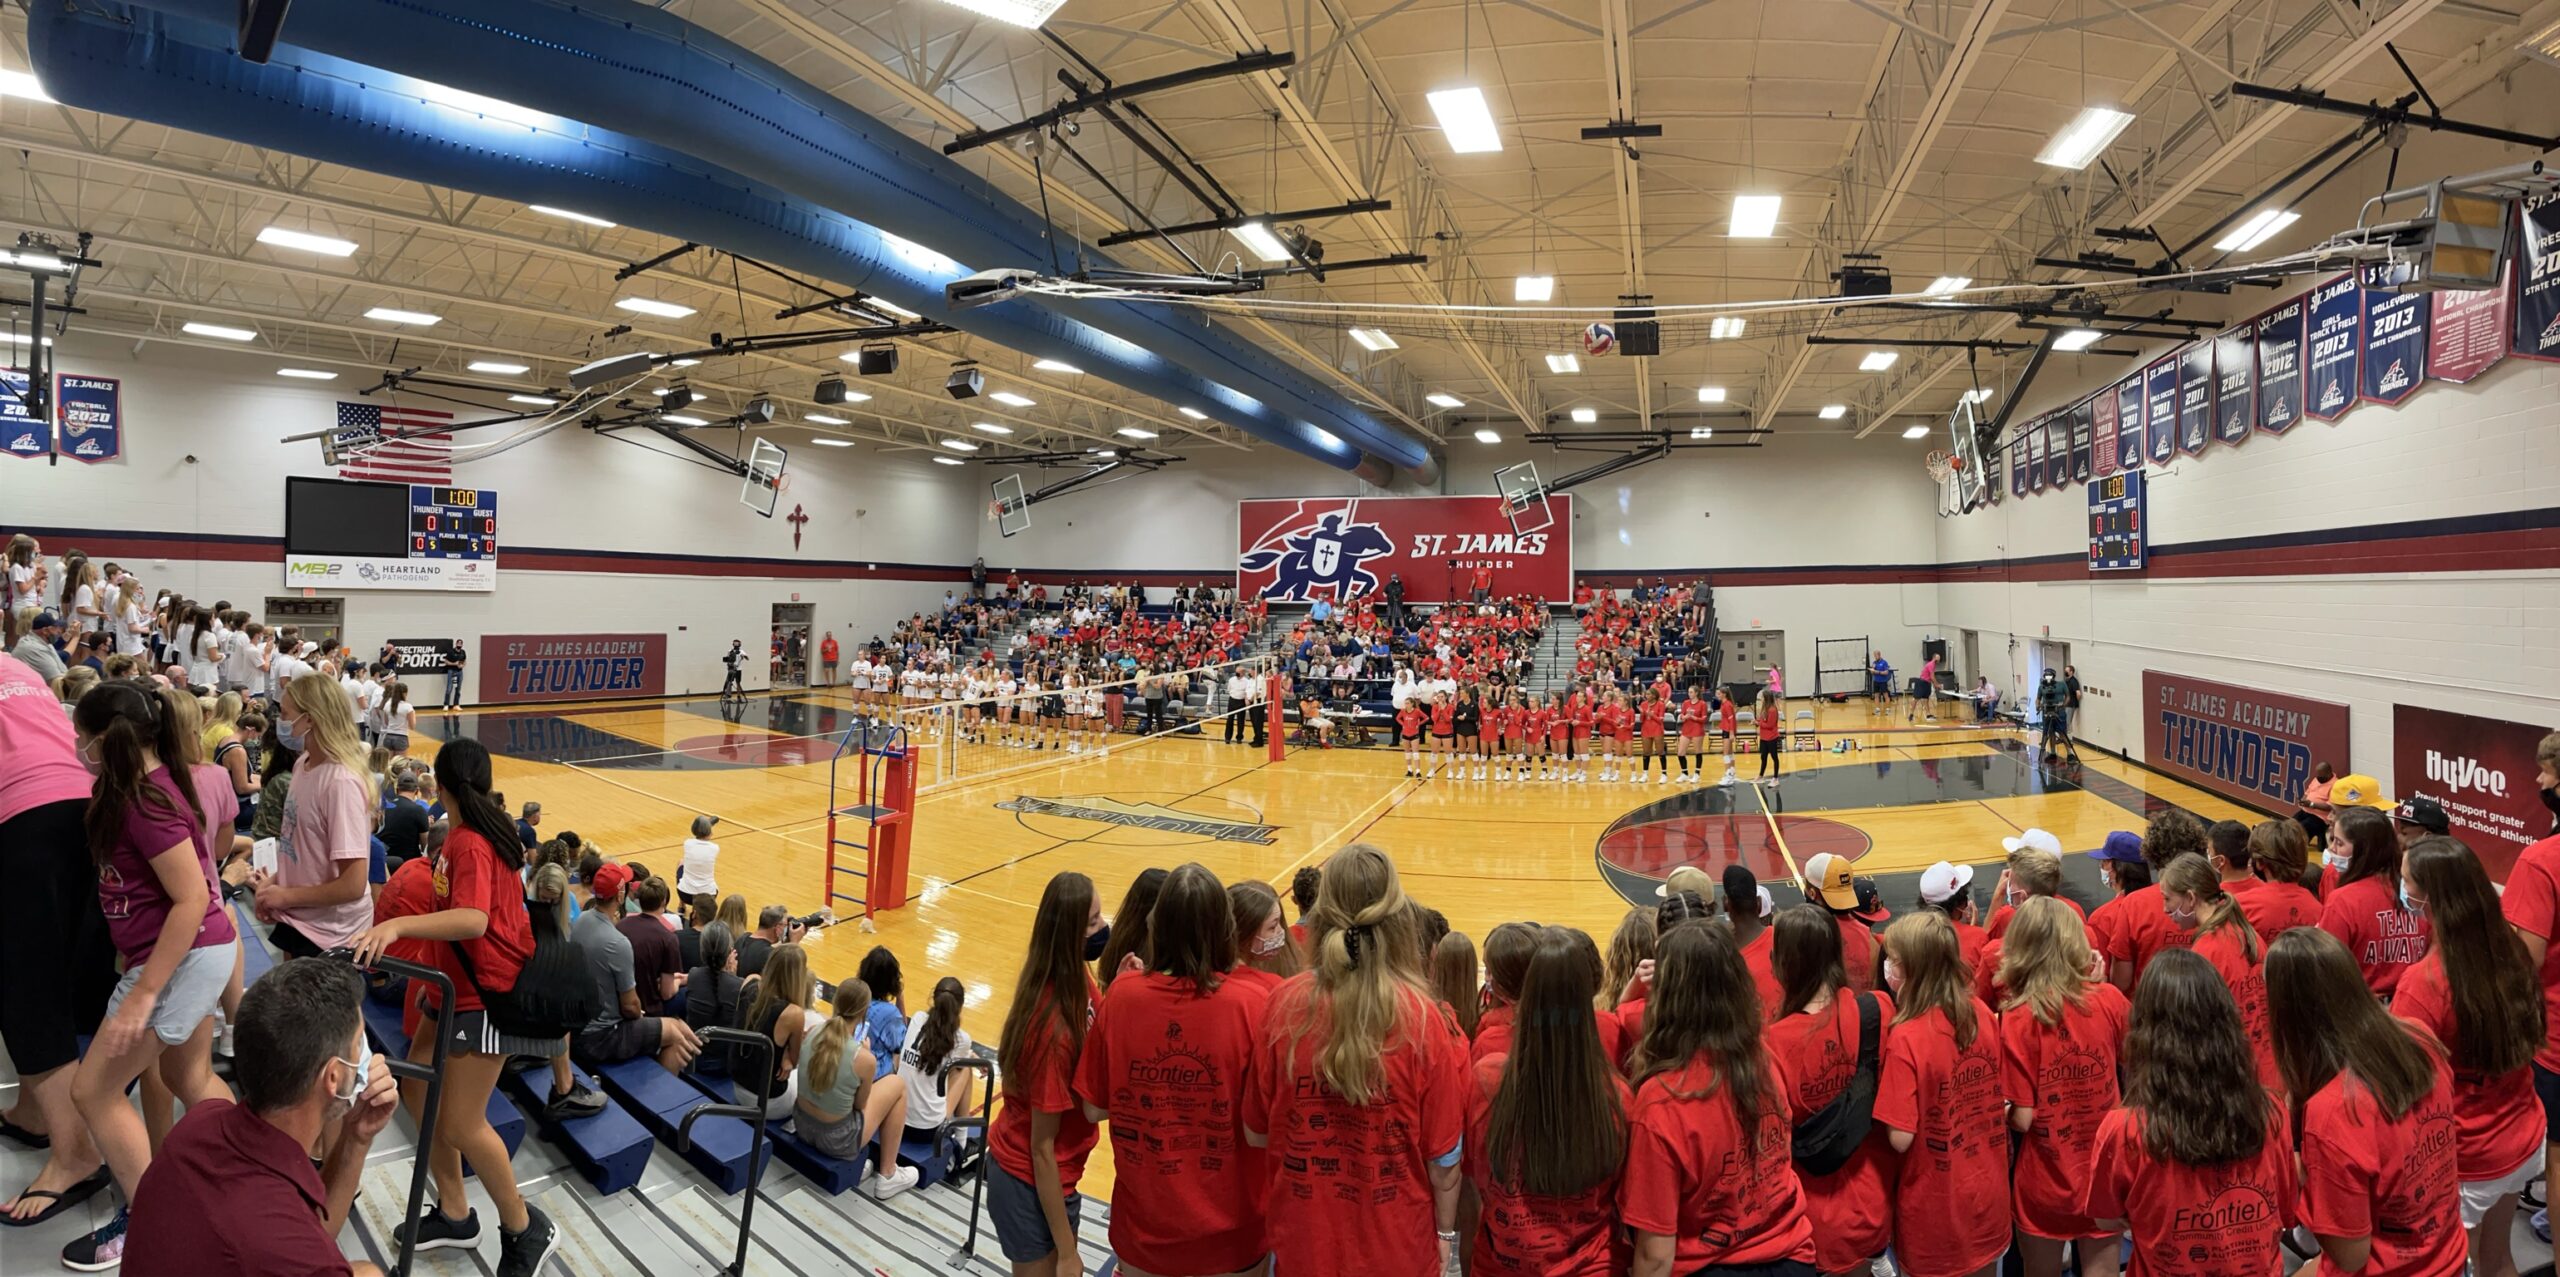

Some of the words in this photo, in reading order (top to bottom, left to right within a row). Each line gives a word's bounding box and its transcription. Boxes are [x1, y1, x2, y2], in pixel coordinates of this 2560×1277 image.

[2323, 278, 2355, 303] JAMES
[2525, 279, 2550, 296] STATE
[2372, 291, 2420, 316] VOLLEYBALL
[2435, 309, 2465, 326] NATIONAL
[2465, 295, 2506, 315] CHAMPIONS
[2272, 303, 2300, 324] JAMES
[2321, 313, 2341, 328] GIRLS
[2373, 305, 2414, 338] 2013
[2310, 327, 2330, 342] TRACK
[2337, 315, 2357, 330] FIELD
[2315, 331, 2349, 360] 2013
[2370, 338, 2387, 350] STATE
[2387, 325, 2421, 344] CHAMPIONS
[2264, 353, 2294, 377] 2012
[2312, 359, 2326, 370] STATE
[2326, 349, 2355, 365] CHAMPIONS
[2157, 361, 2175, 376] JAMES
[64, 378, 78, 388] ST.
[79, 379, 114, 391] JAMES
[2183, 374, 2208, 390] VOLLEYBALL
[2222, 371, 2246, 393] 2012
[2379, 377, 2409, 396] THUNDER
[2185, 387, 2205, 406] 2011
[2320, 396, 2344, 411] THUNDER
[67, 410, 111, 423] 2020
[2153, 400, 2170, 418] 2011
[2122, 413, 2138, 429] 2011
[2108, 476, 2124, 497] 1:00
[450, 490, 475, 506] 1:00
[2123, 498, 2137, 509] GUEST
[413, 505, 443, 514] THUNDER
[473, 509, 494, 517] GUEST
[2089, 503, 2106, 514] THUNDER
[428, 515, 436, 531] 0
[454, 519, 458, 530] 1
[486, 518, 494, 534] 0
[2096, 516, 2103, 534] 0
[2112, 517, 2115, 529] 1
[2131, 510, 2138, 530] 0
[417, 537, 424, 550] 0
[486, 540, 493, 553] 0
[1411, 534, 1446, 558] ST.
[1450, 533, 1549, 556] JAMES
[2092, 544, 2097, 559] 0
[2132, 540, 2138, 556] 0
[290, 562, 343, 575] MB2
[382, 565, 441, 575] HEARTLAND
[395, 646, 436, 654] SPECTRUM
[507, 642, 529, 656] ST.
[536, 642, 583, 656] JAMES
[585, 641, 646, 655] ACADEMY
[396, 653, 447, 668] PORTS
[507, 656, 645, 695] THUNDER
[2160, 685, 2177, 707] ST.
[2183, 690, 2226, 718] JAMES
[2232, 700, 2311, 738] ACADEMY
[2160, 709, 2312, 806] THUNDER
[2402, 804, 2415, 818] 23
[2441, 796, 2450, 808] to
[2452, 801, 2487, 818] support
[2489, 811, 2526, 829] greater
[2447, 810, 2466, 827] high
[2468, 819, 2499, 836] school
[2376, 909, 2418, 937] TEAM
[902, 1049, 921, 1068] NOR
[1129, 1060, 1206, 1083] Frontier
[2038, 1062, 2097, 1082] Frontier
[1800, 1072, 1853, 1095] Frontie
[2173, 1199, 2264, 1230] Frontier
[2172, 1231, 2224, 1241] Community
[2226, 1225, 2254, 1236] Credit
[2211, 1238, 2260, 1252] PLATINUM
[2211, 1242, 2270, 1259] AUTOMOTIVE
